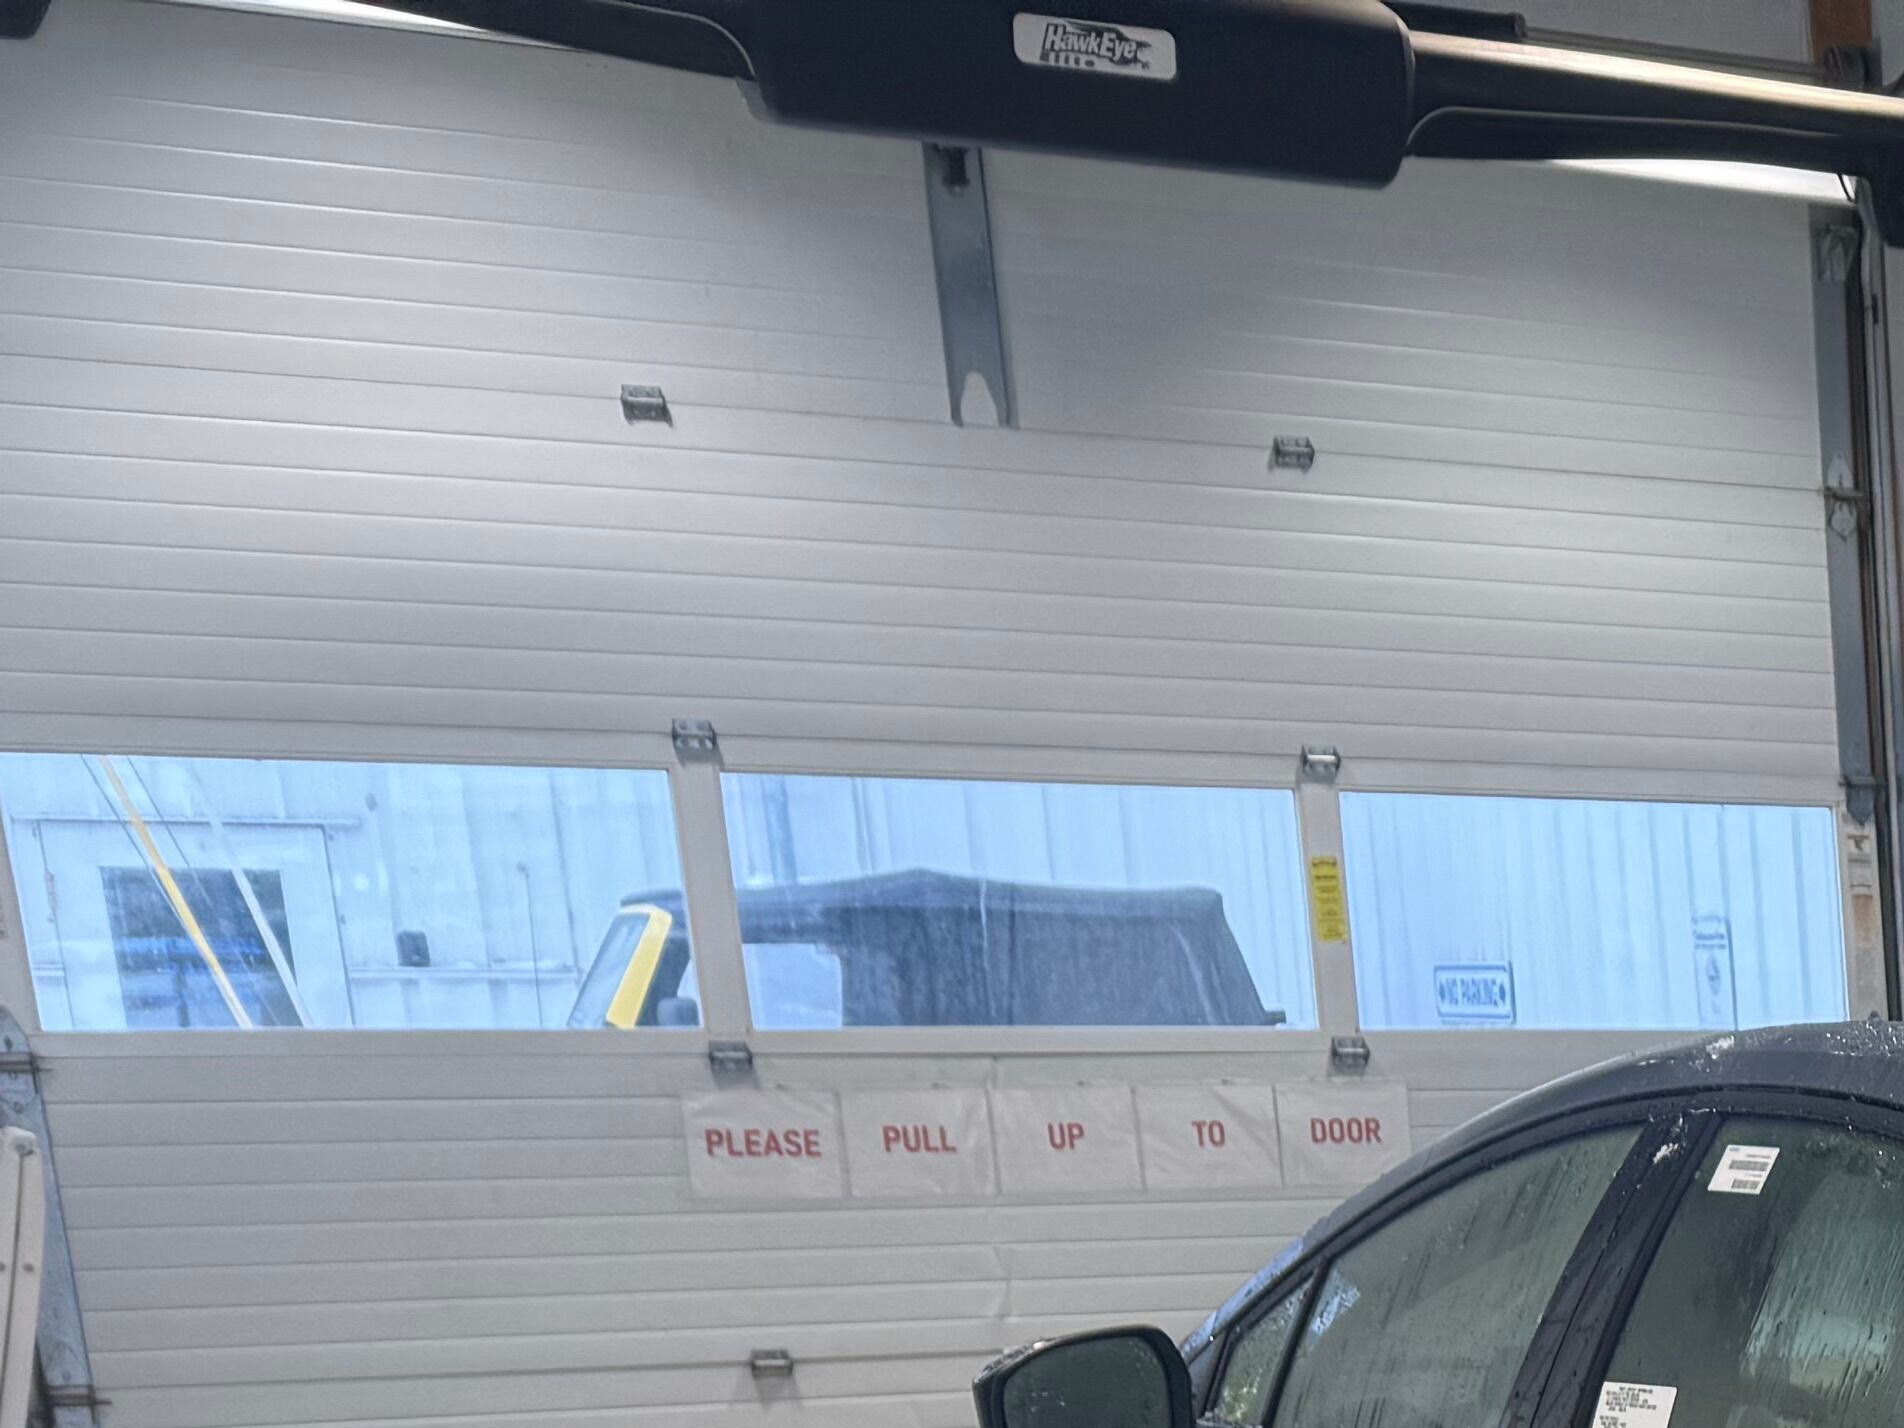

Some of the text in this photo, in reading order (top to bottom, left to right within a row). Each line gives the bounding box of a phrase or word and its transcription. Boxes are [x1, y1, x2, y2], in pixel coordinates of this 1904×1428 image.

[1044, 23, 1137, 61] HawkEye
[1460, 978, 1498, 1007] PARKING
[705, 1117, 1383, 1157] PLEASE PULL UP TO DOOR
